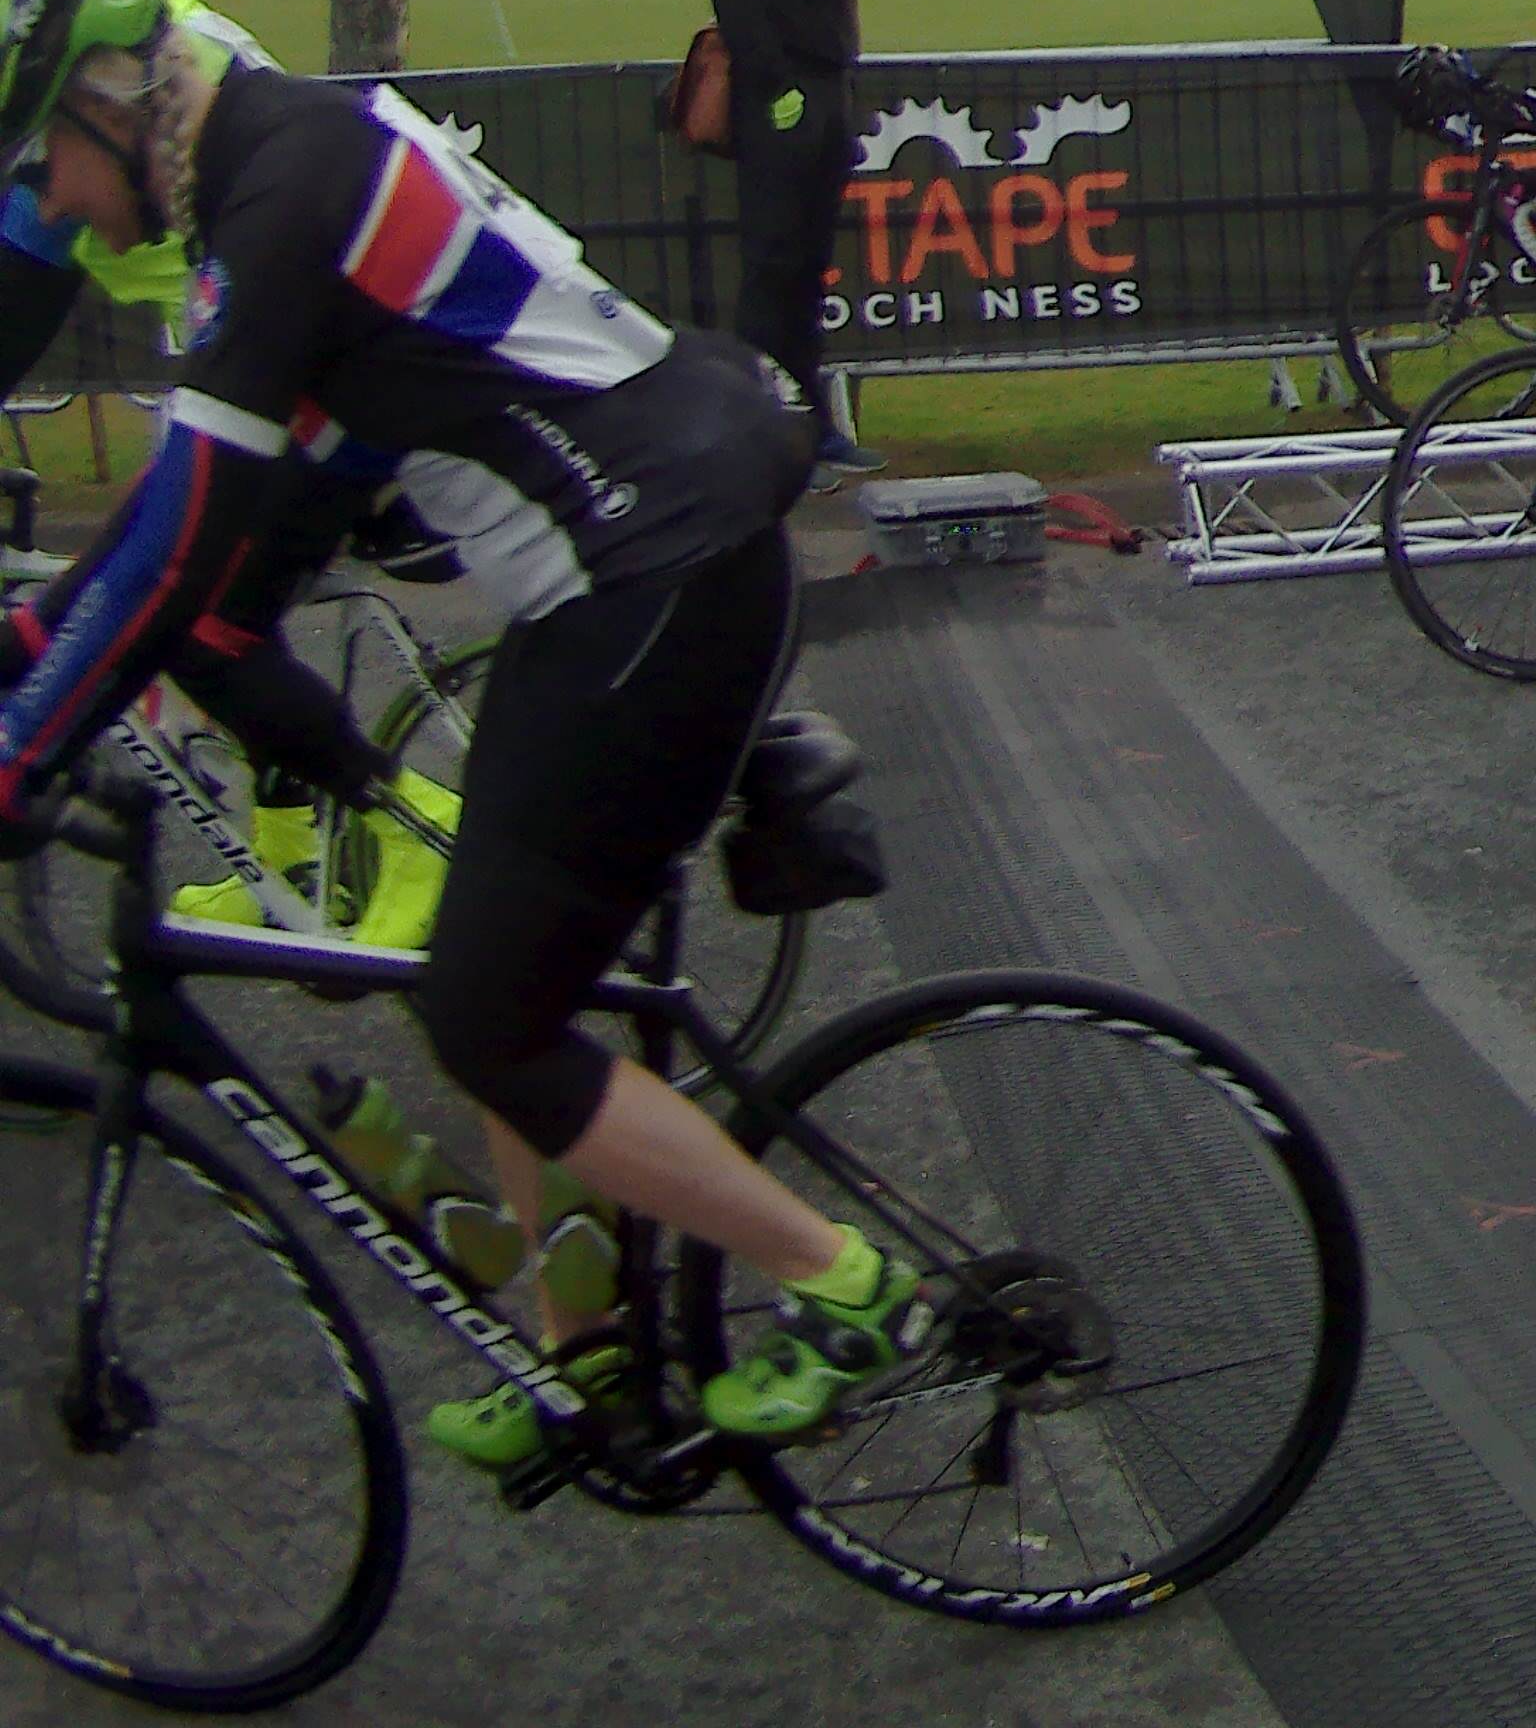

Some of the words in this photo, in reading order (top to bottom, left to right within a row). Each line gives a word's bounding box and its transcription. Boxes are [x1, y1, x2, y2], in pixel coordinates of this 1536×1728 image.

[821, 170, 1136, 286] TAPE
[820, 290, 944, 331] OCH
[980, 280, 1142, 322] NESS
[106, 718, 265, 883] nondale
[205, 1076, 587, 1416] cannondale
